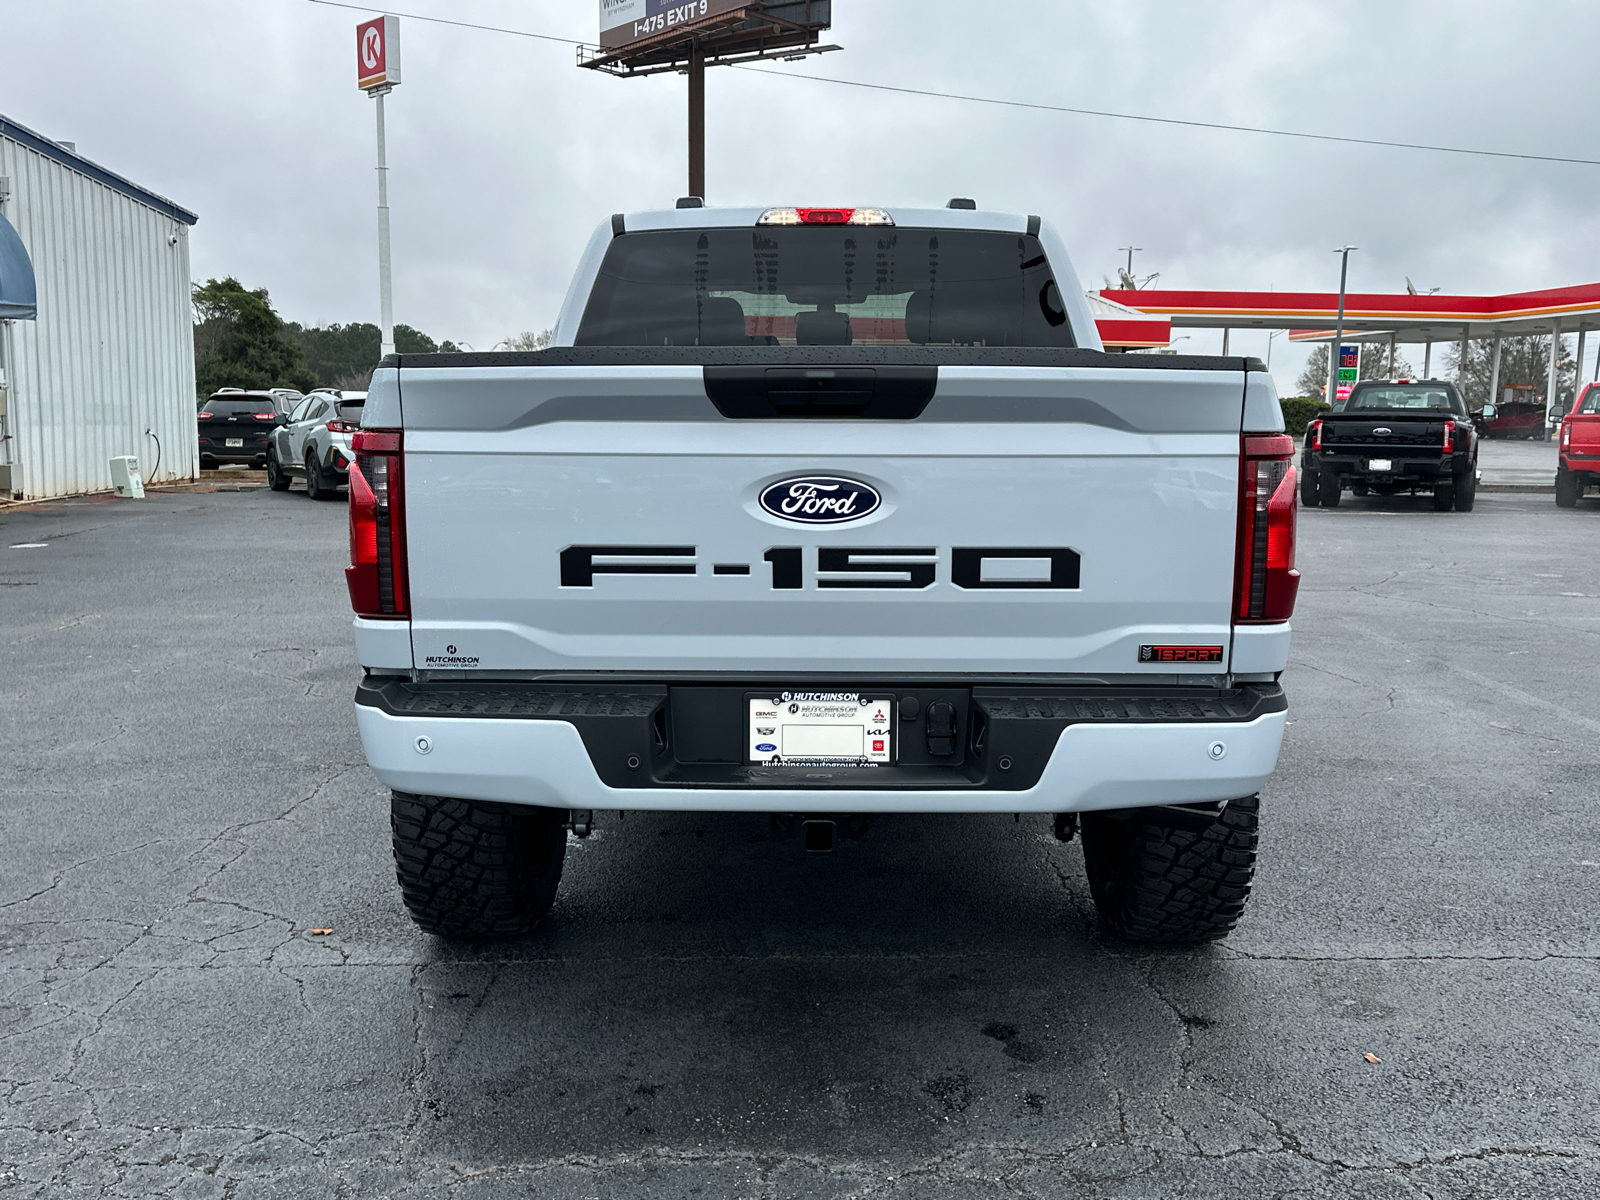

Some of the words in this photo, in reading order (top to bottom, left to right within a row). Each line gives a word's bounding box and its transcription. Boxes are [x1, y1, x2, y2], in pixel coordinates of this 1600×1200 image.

[634, 13, 664, 37] I-475
[667, 2, 697, 26] EXIT
[699, 0, 708, 15] 9
[366, 33, 379, 63] K
[781, 482, 858, 514] Ford
[559, 545, 1081, 589] F-150
[793, 692, 860, 701] HUTCHINSON
[801, 705, 859, 713] HUTCHINSON
[762, 760, 879, 768] Hutchinsonautogroupcom
